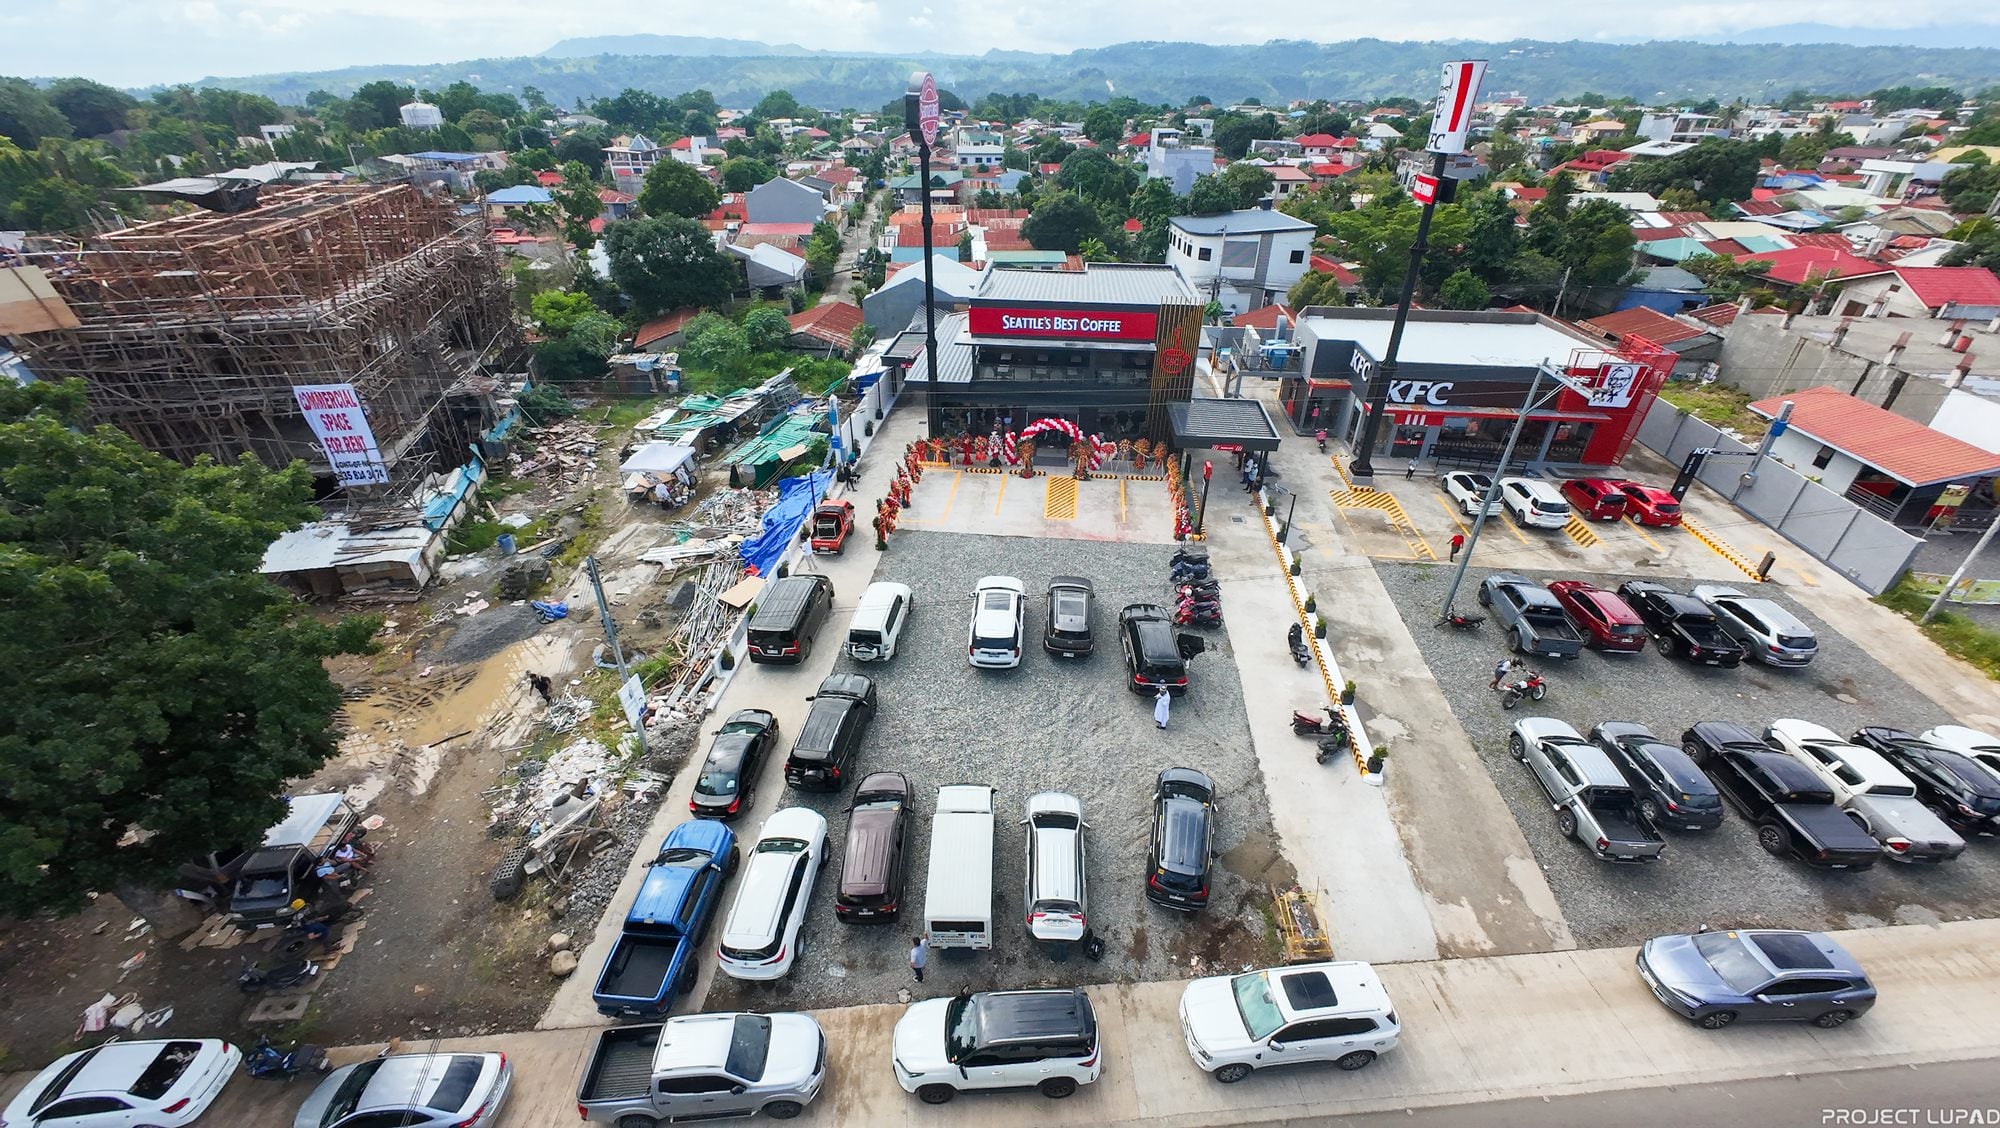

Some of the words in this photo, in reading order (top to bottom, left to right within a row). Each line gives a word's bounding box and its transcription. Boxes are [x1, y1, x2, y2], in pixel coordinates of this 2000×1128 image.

[1002, 315, 1051, 329] SEATTLE'S
[1053, 317, 1078, 331] BEST
[1080, 318, 1121, 332] COFFEE
[1349, 348, 1371, 382] KFC
[1386, 380, 1454, 405] KFC
[320, 412, 353, 431] SPACE
[324, 437, 343, 454] FOR
[342, 435, 368, 454] RENT
[1693, 447, 1717, 455] KFC
